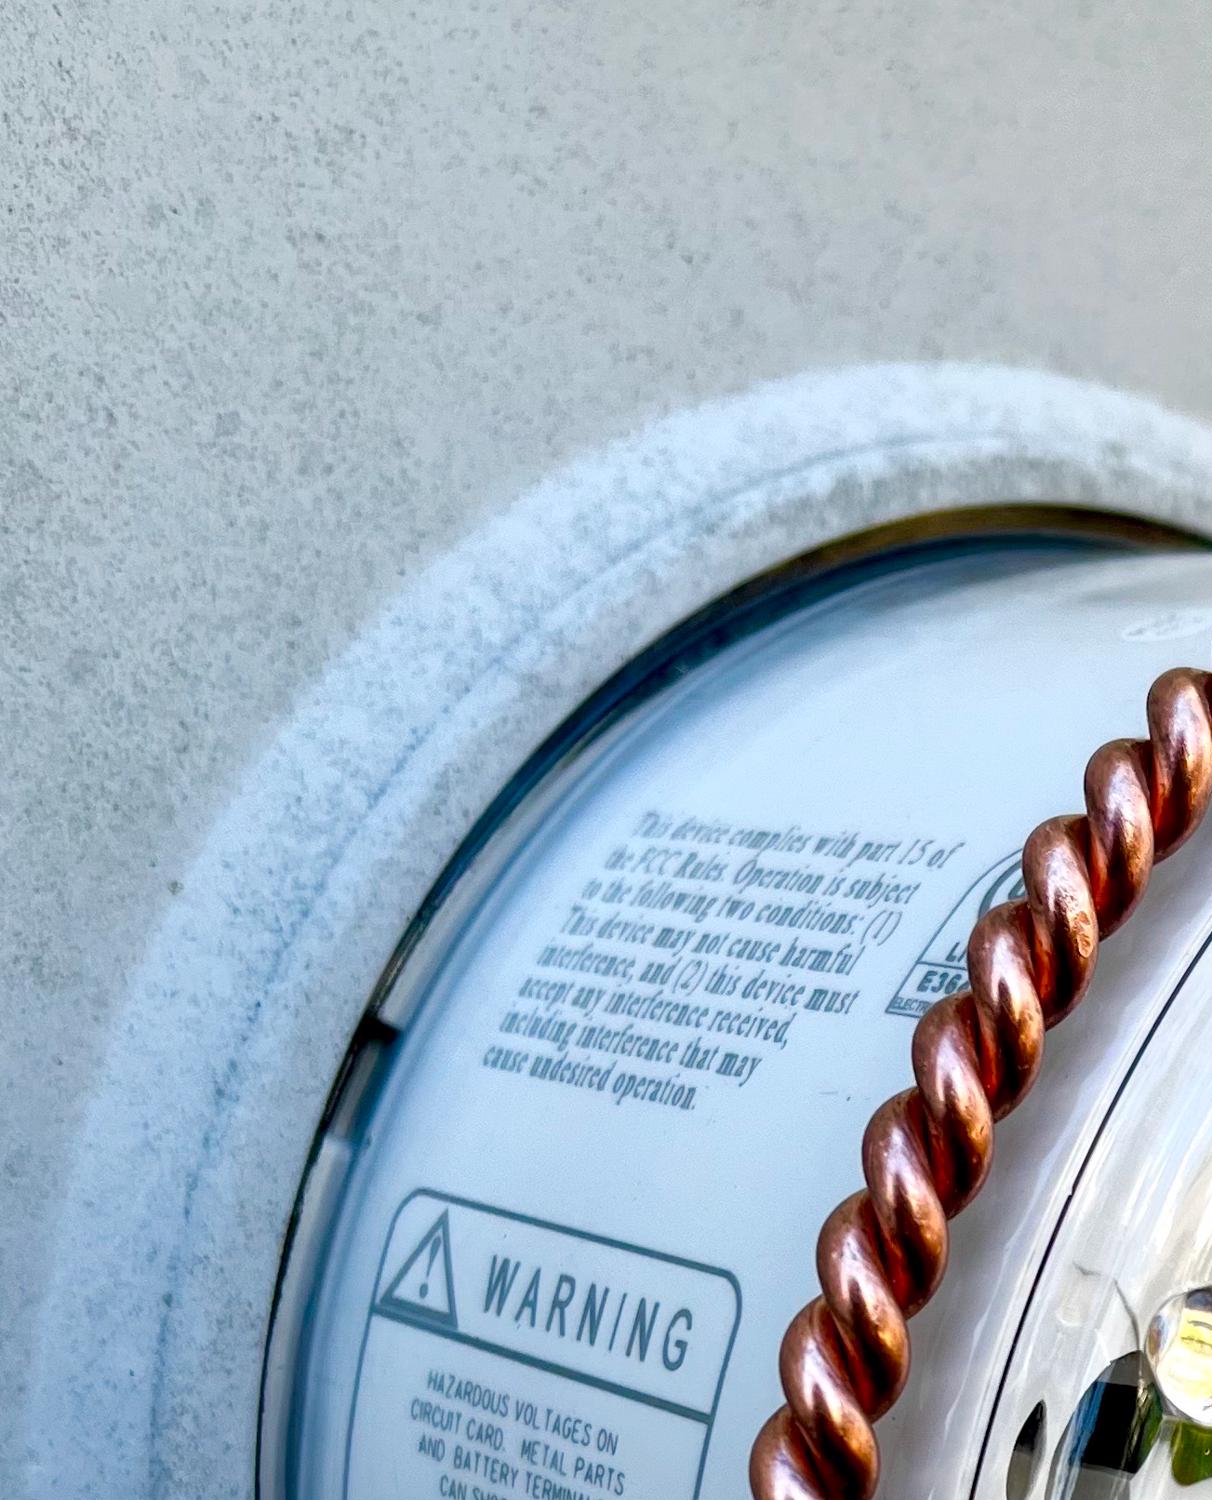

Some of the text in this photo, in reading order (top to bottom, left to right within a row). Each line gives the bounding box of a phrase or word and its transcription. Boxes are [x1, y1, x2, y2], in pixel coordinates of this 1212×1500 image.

[603, 844, 922, 910] the FCC Rules. Operation is subject
[634, 811, 966, 872] This device complies with part 15 of
[559, 904, 867, 977] This device may not cause harmful
[601, 877, 632, 903] the
[630, 880, 719, 925] following
[717, 896, 754, 921] two
[753, 901, 865, 935] conditions:
[860, 909, 903, 945] (1)
[517, 973, 798, 1051] accept any interference received,
[535, 945, 860, 1016] interference, and (2) this device must
[482, 1041, 698, 1111] cause undesired operation.
[499, 1002, 764, 1088] including interference that may
[483, 1253, 694, 1374] WARNING
[410, 1397, 463, 1434] CIRCUIT
[520, 1438, 568, 1477] METAL
[573, 1455, 626, 1497] PARTS
[427, 1369, 620, 1457] HAZARDOUS VOLTAGES ON
[418, 1431, 447, 1464] AND
[453, 1444, 520, 1489] BATTERY
